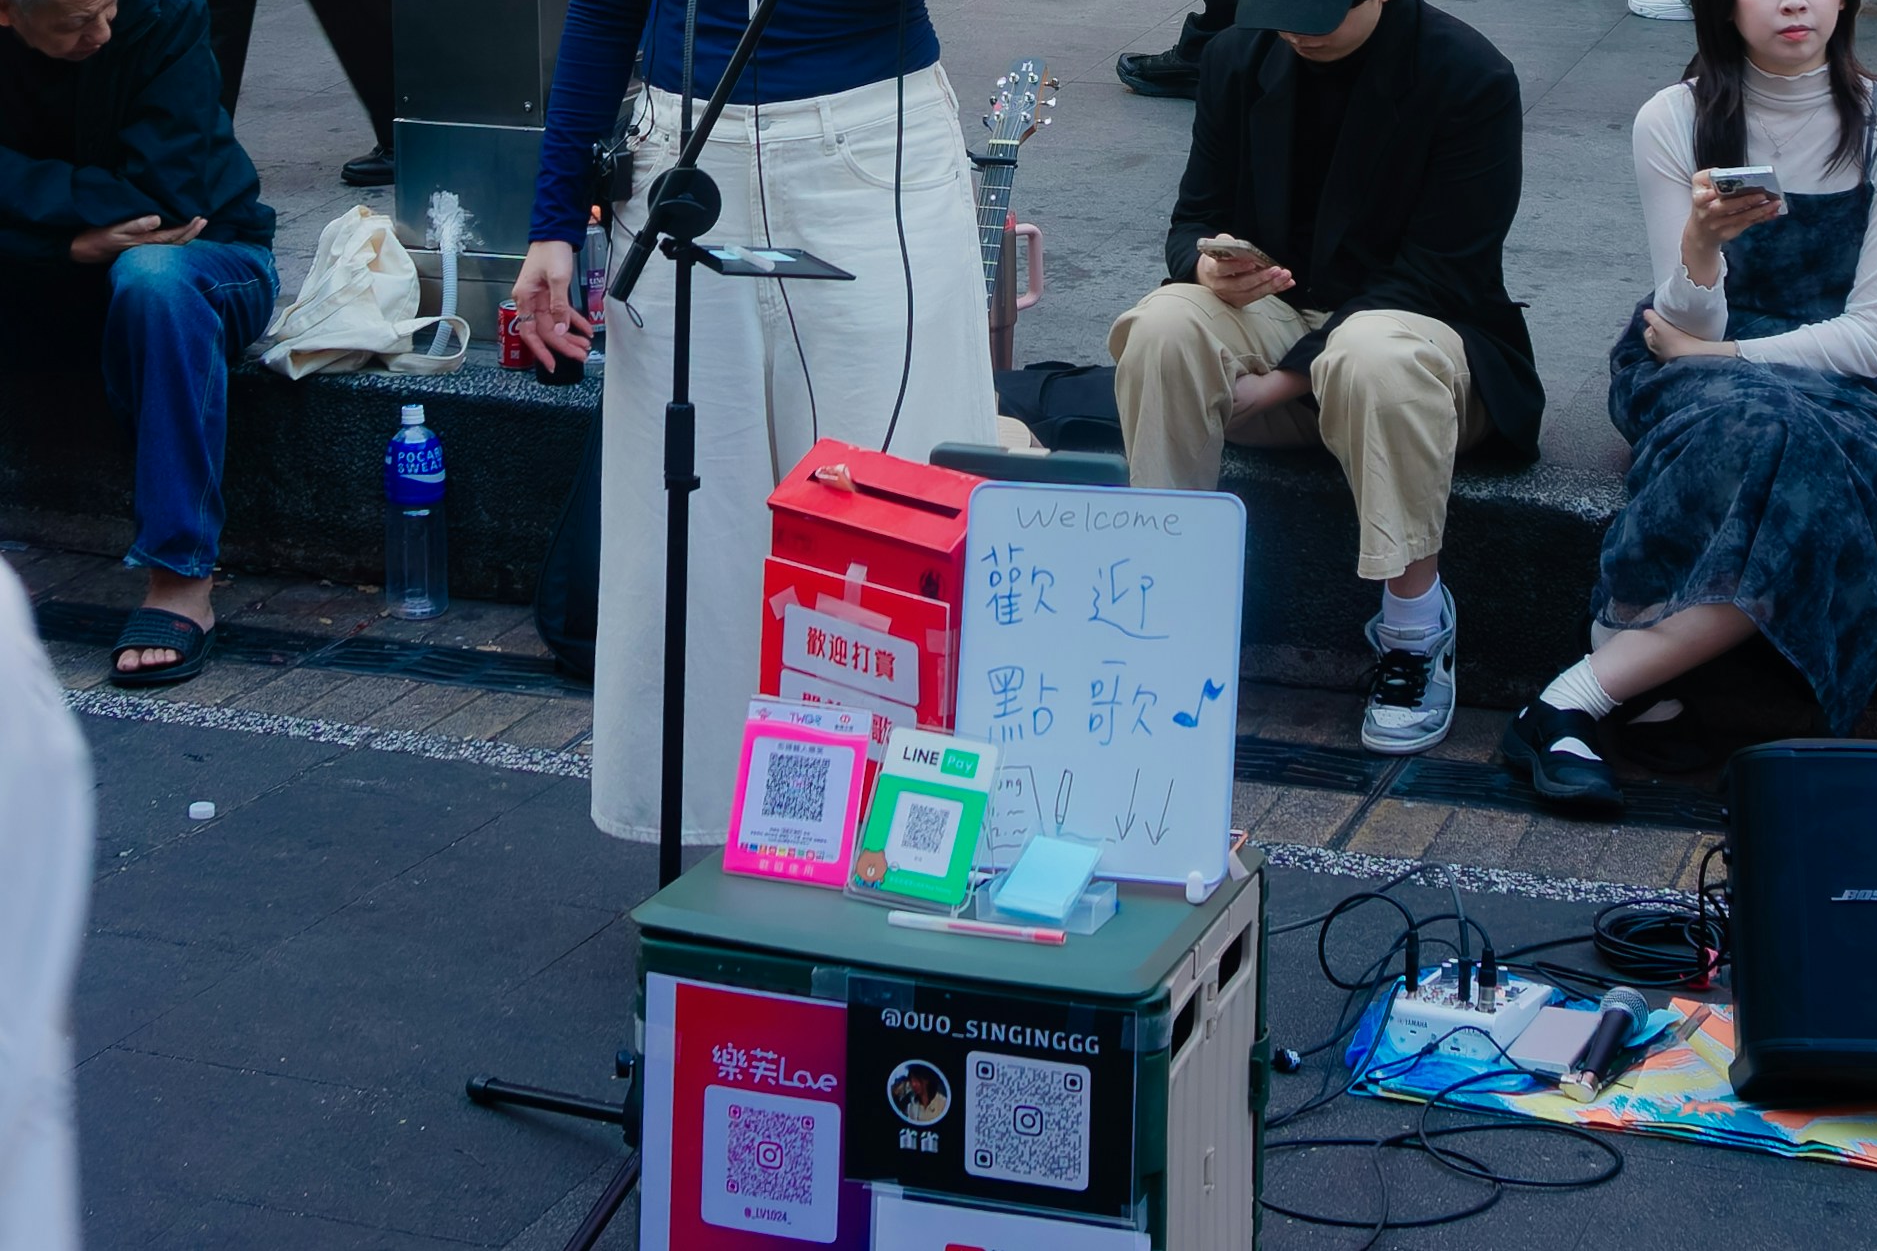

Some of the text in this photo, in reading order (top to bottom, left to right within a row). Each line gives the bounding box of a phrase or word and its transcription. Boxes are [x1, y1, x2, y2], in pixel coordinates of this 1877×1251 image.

[1016, 502, 1183, 536] Welcome
[980, 542, 1170, 640] 歡迎
[806, 626, 896, 682] 歡迎打賞
[987, 661, 1159, 747] 點歌
[902, 746, 974, 775] LINE Pay
[880, 1007, 1100, 1055] @OUO_SINGINGGG
[1404, 1018, 1429, 1029] YAMAHA
